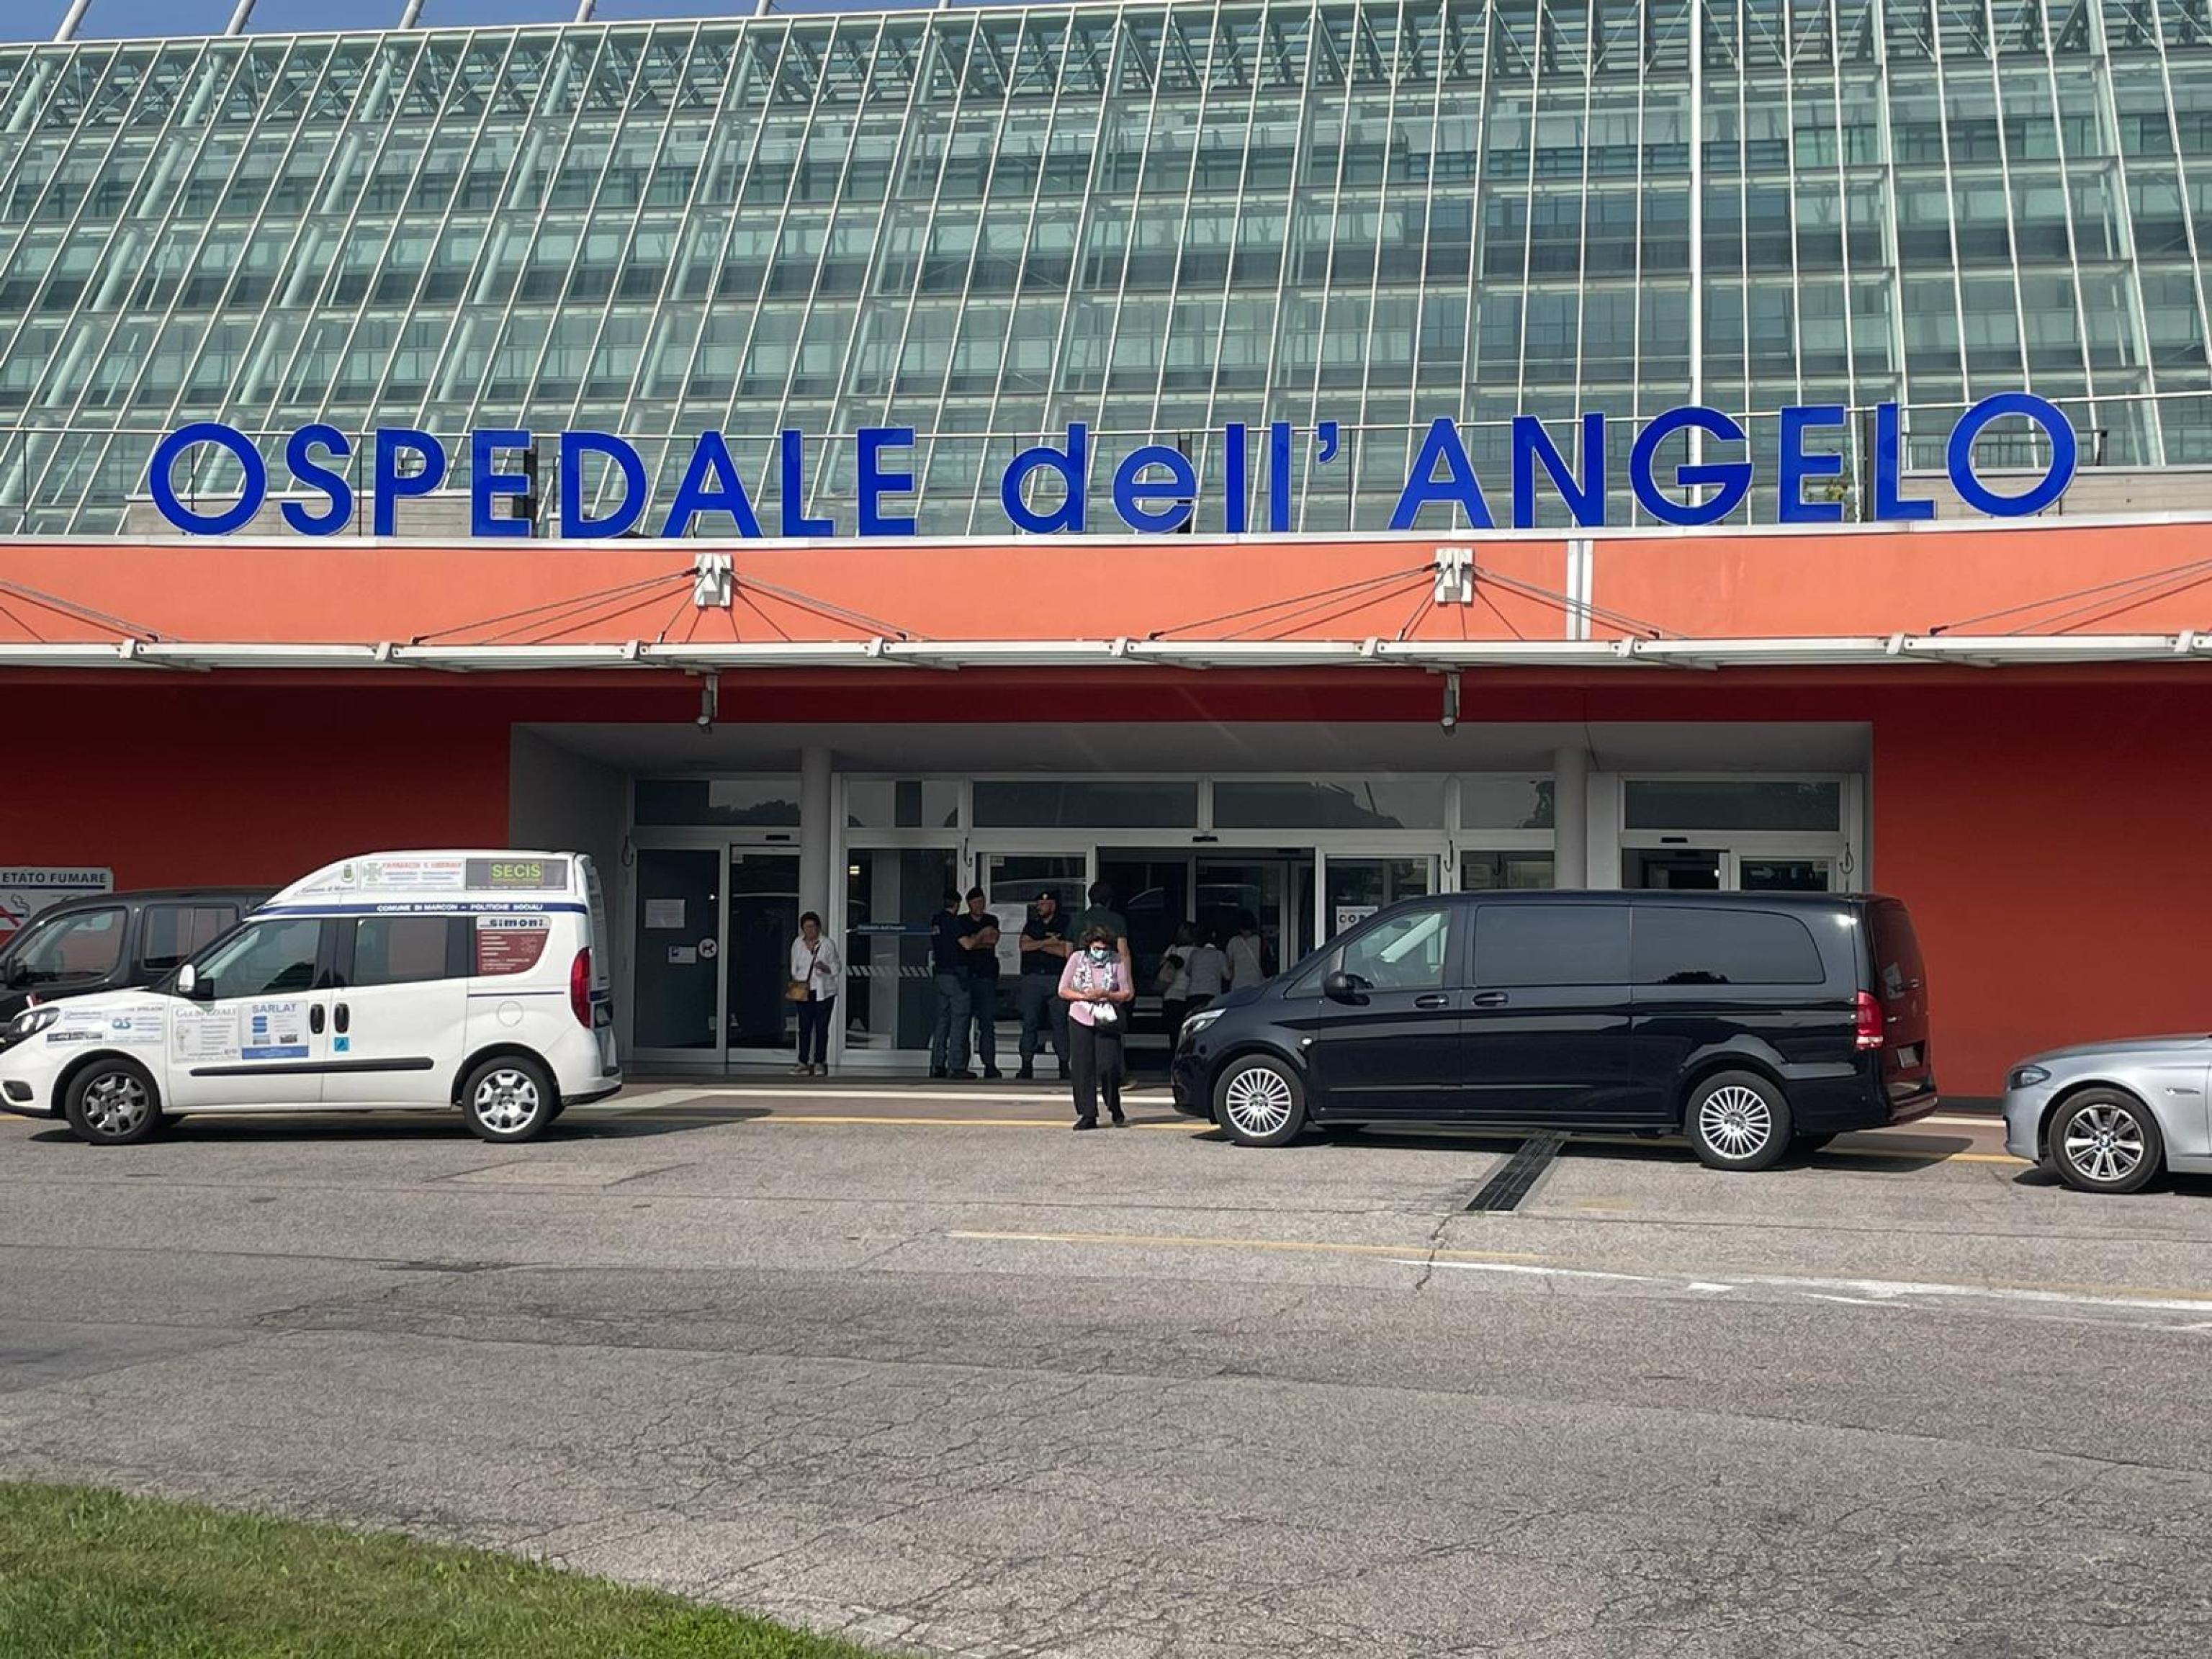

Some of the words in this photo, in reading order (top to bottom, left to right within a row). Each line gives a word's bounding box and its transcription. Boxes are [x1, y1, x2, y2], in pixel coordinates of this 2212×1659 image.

[148, 421, 917, 539] OSPEDALE
[1389, 391, 2078, 531] ANGELO
[491, 863, 541, 878] SECIS
[50, 873, 106, 883] FUMARE
[252, 1003, 297, 1014] SARLAT
